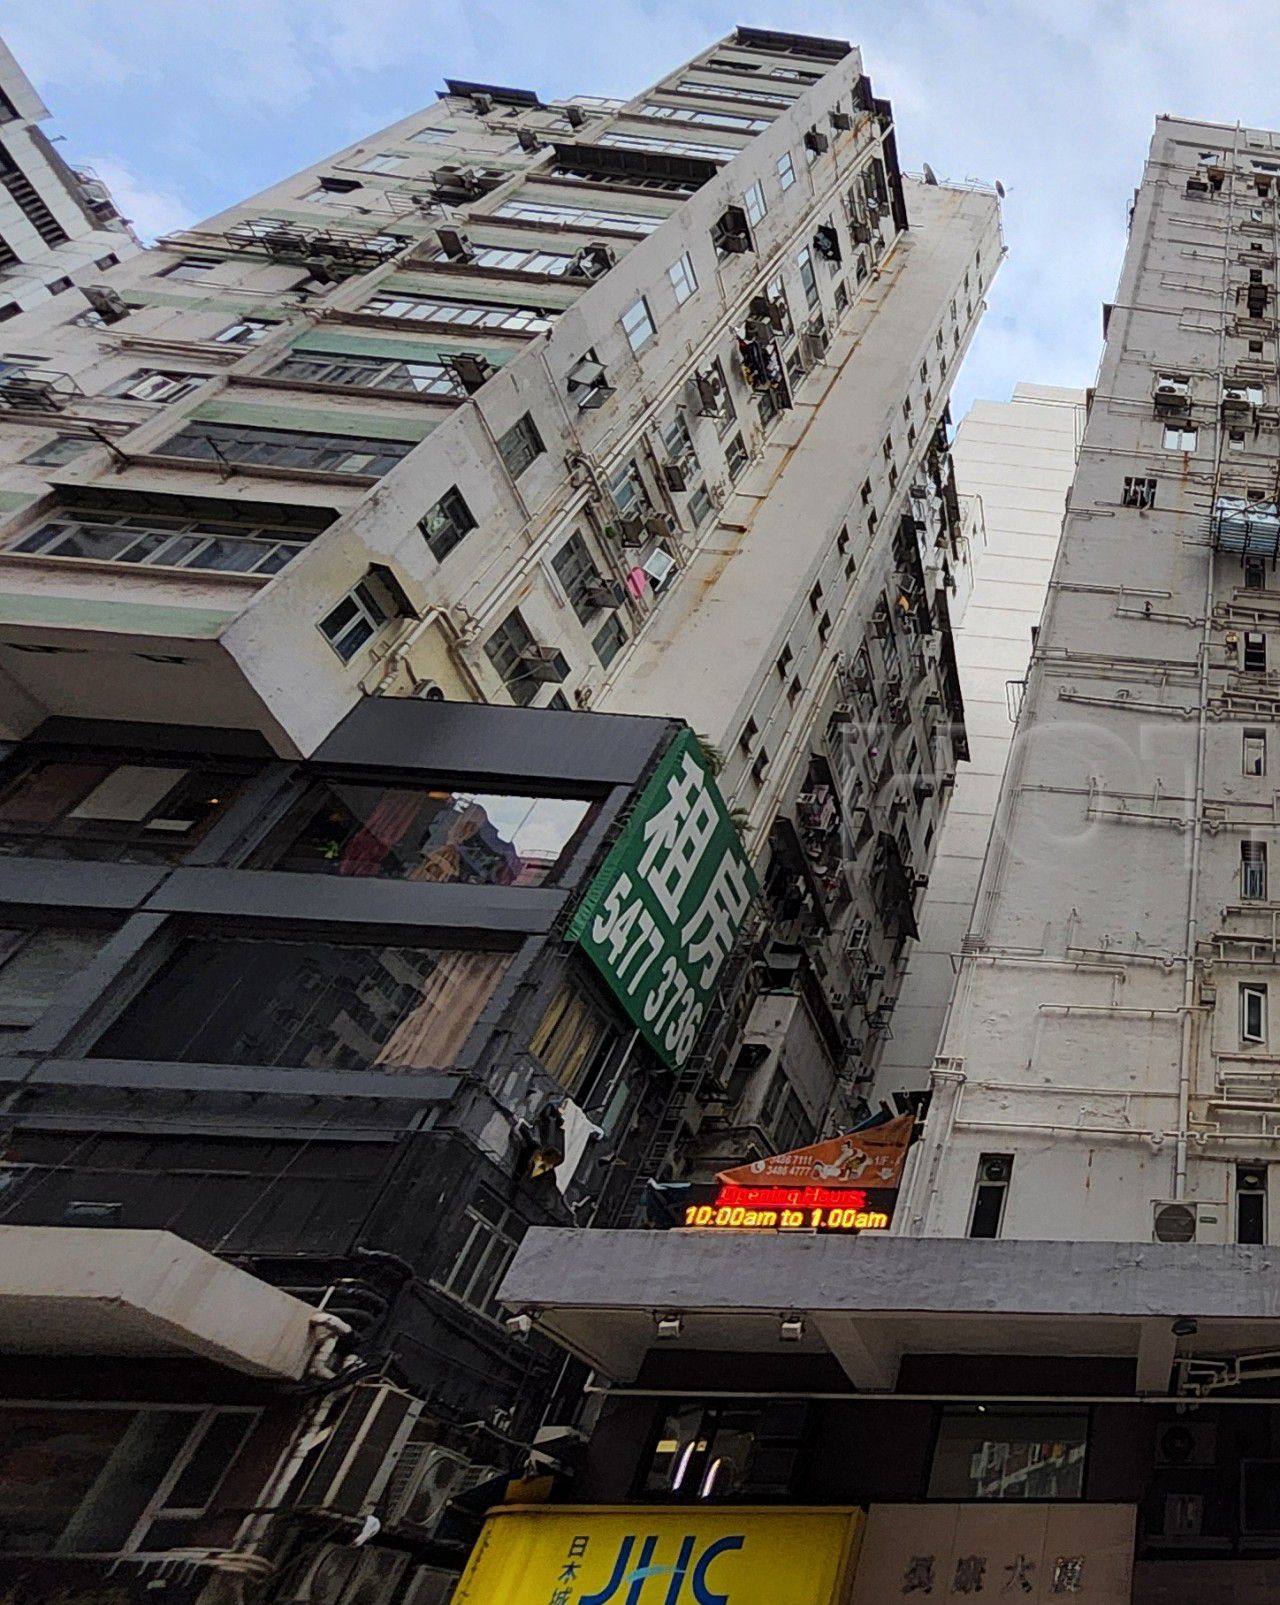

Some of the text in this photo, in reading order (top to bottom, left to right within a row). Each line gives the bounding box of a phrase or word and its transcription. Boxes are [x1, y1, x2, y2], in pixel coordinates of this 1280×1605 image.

[637, 750, 750, 990] 租房
[592, 872, 704, 1066] 5477 3736
[685, 1206, 777, 1226] 10:00am
[779, 1208, 804, 1226] to
[720, 1186, 800, 1205] Opening
[578, 1536, 745, 1605] JHC
